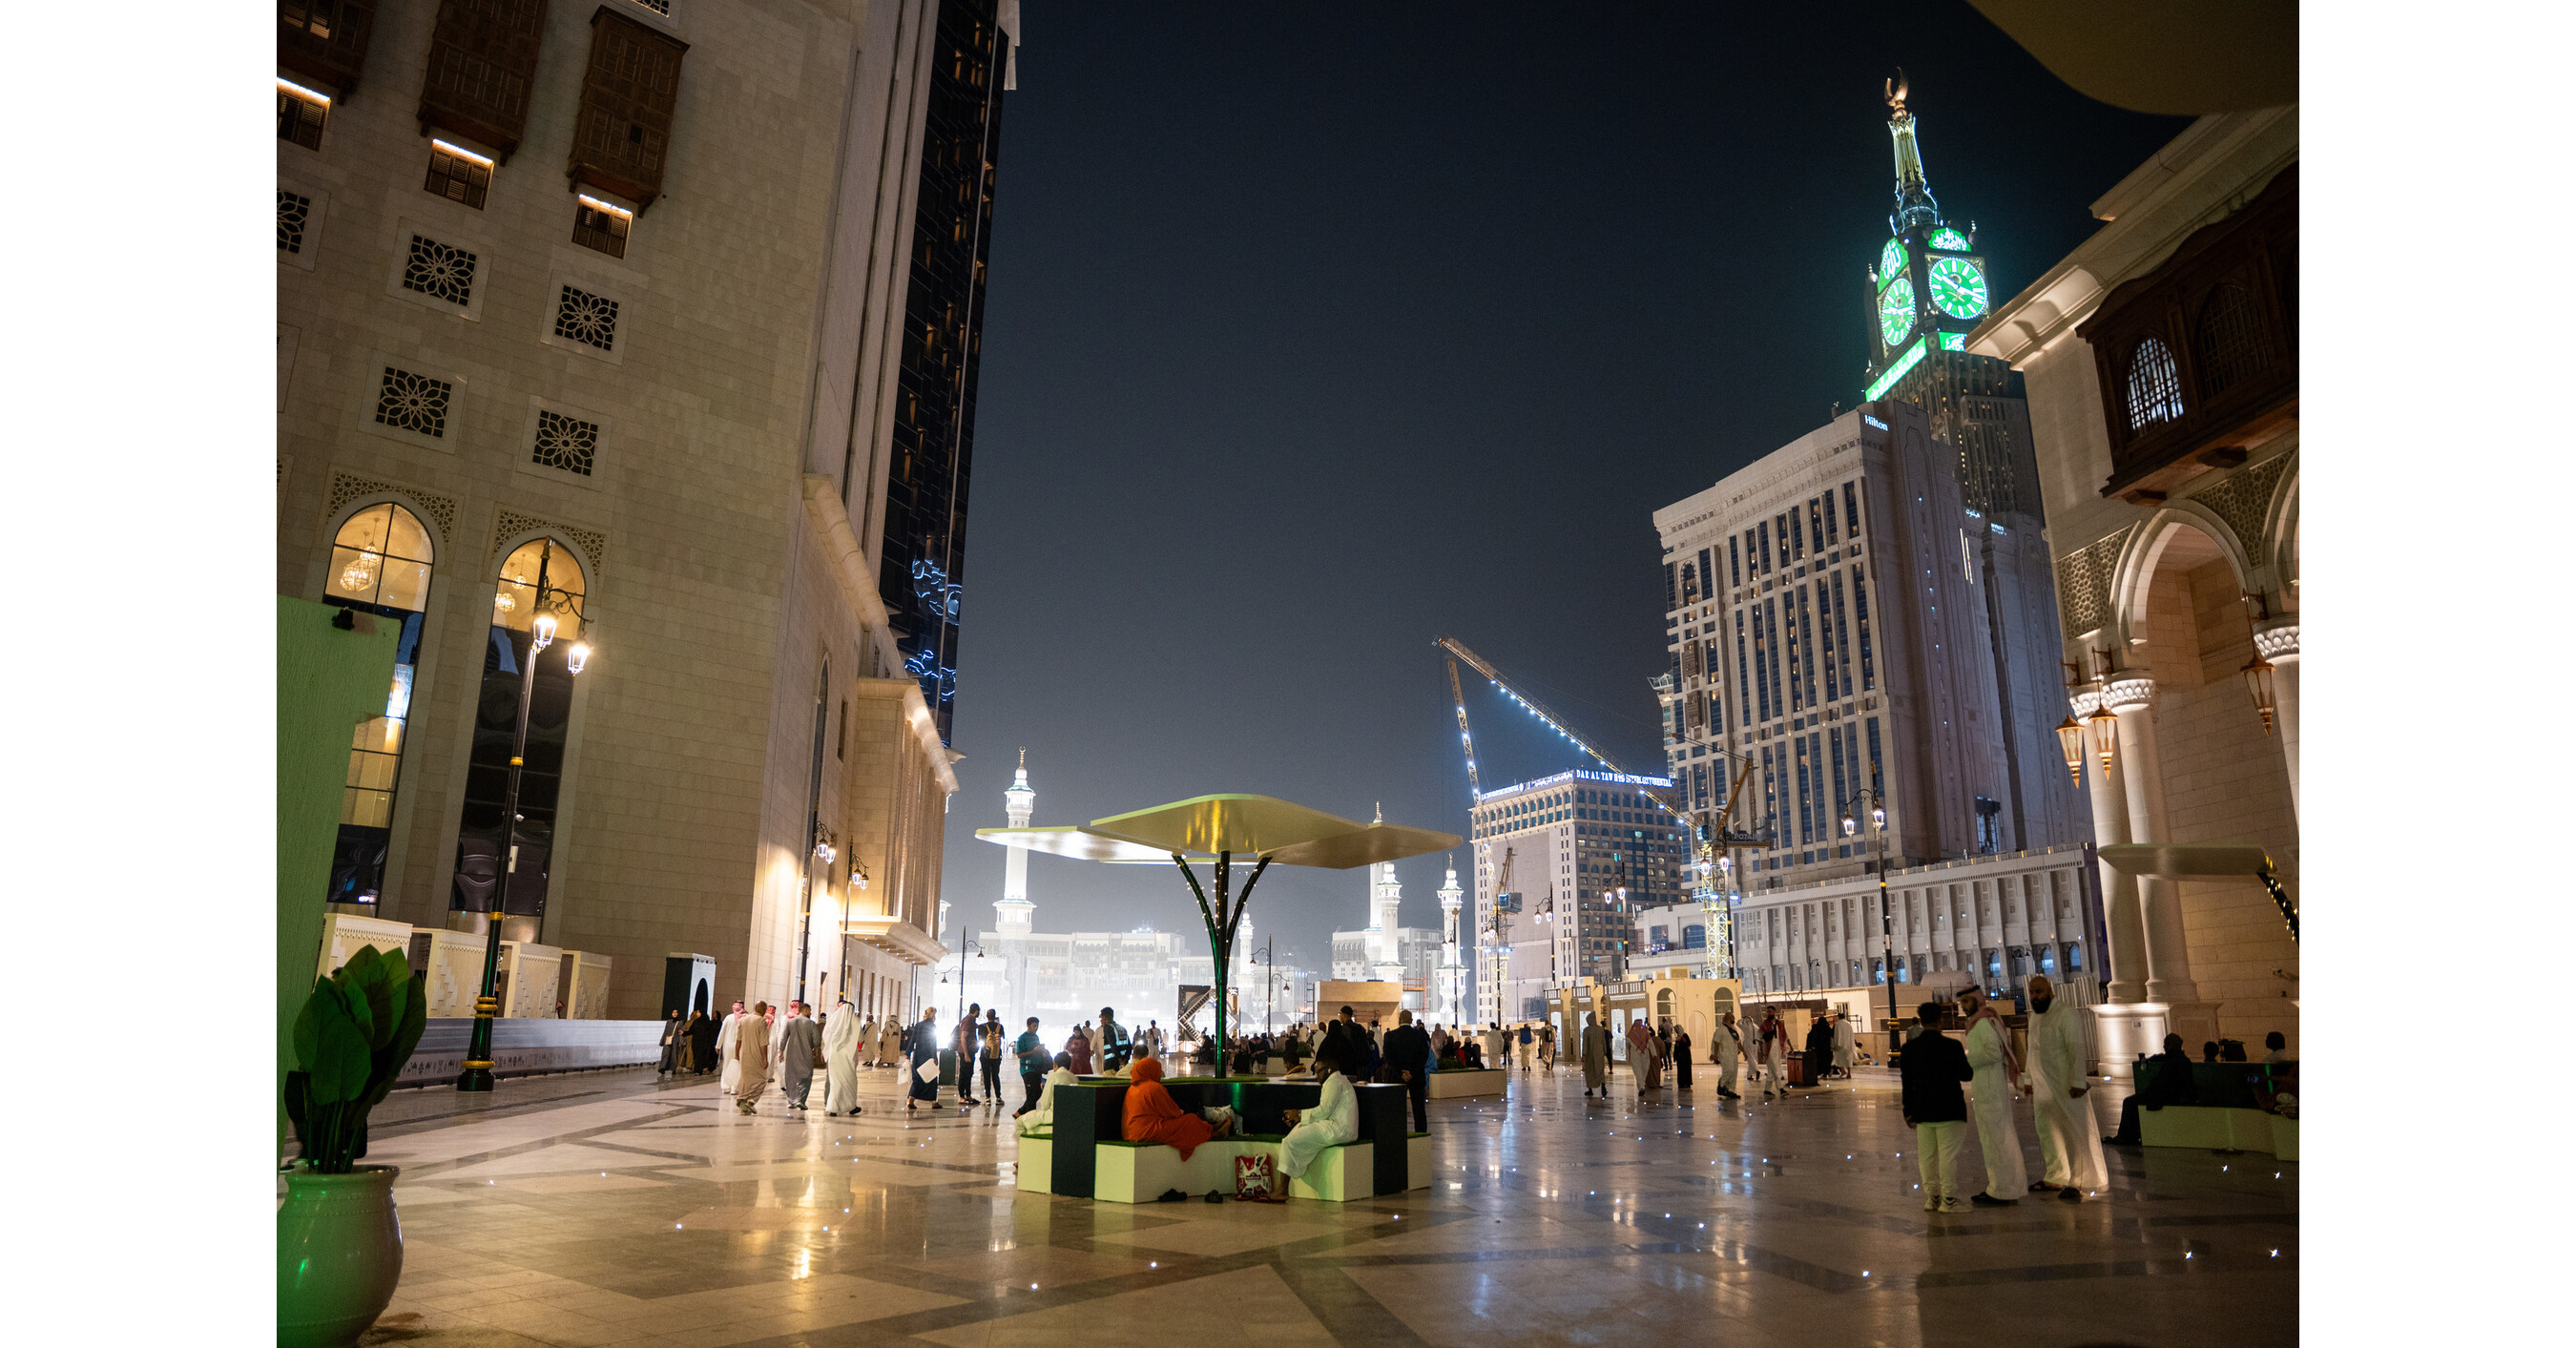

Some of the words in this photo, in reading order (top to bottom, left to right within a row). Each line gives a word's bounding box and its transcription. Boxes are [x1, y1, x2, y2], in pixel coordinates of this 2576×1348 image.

[1864, 414, 1889, 431] Hilton
[1576, 769, 1589, 779] DAR
[1590, 771, 1600, 780] AL
